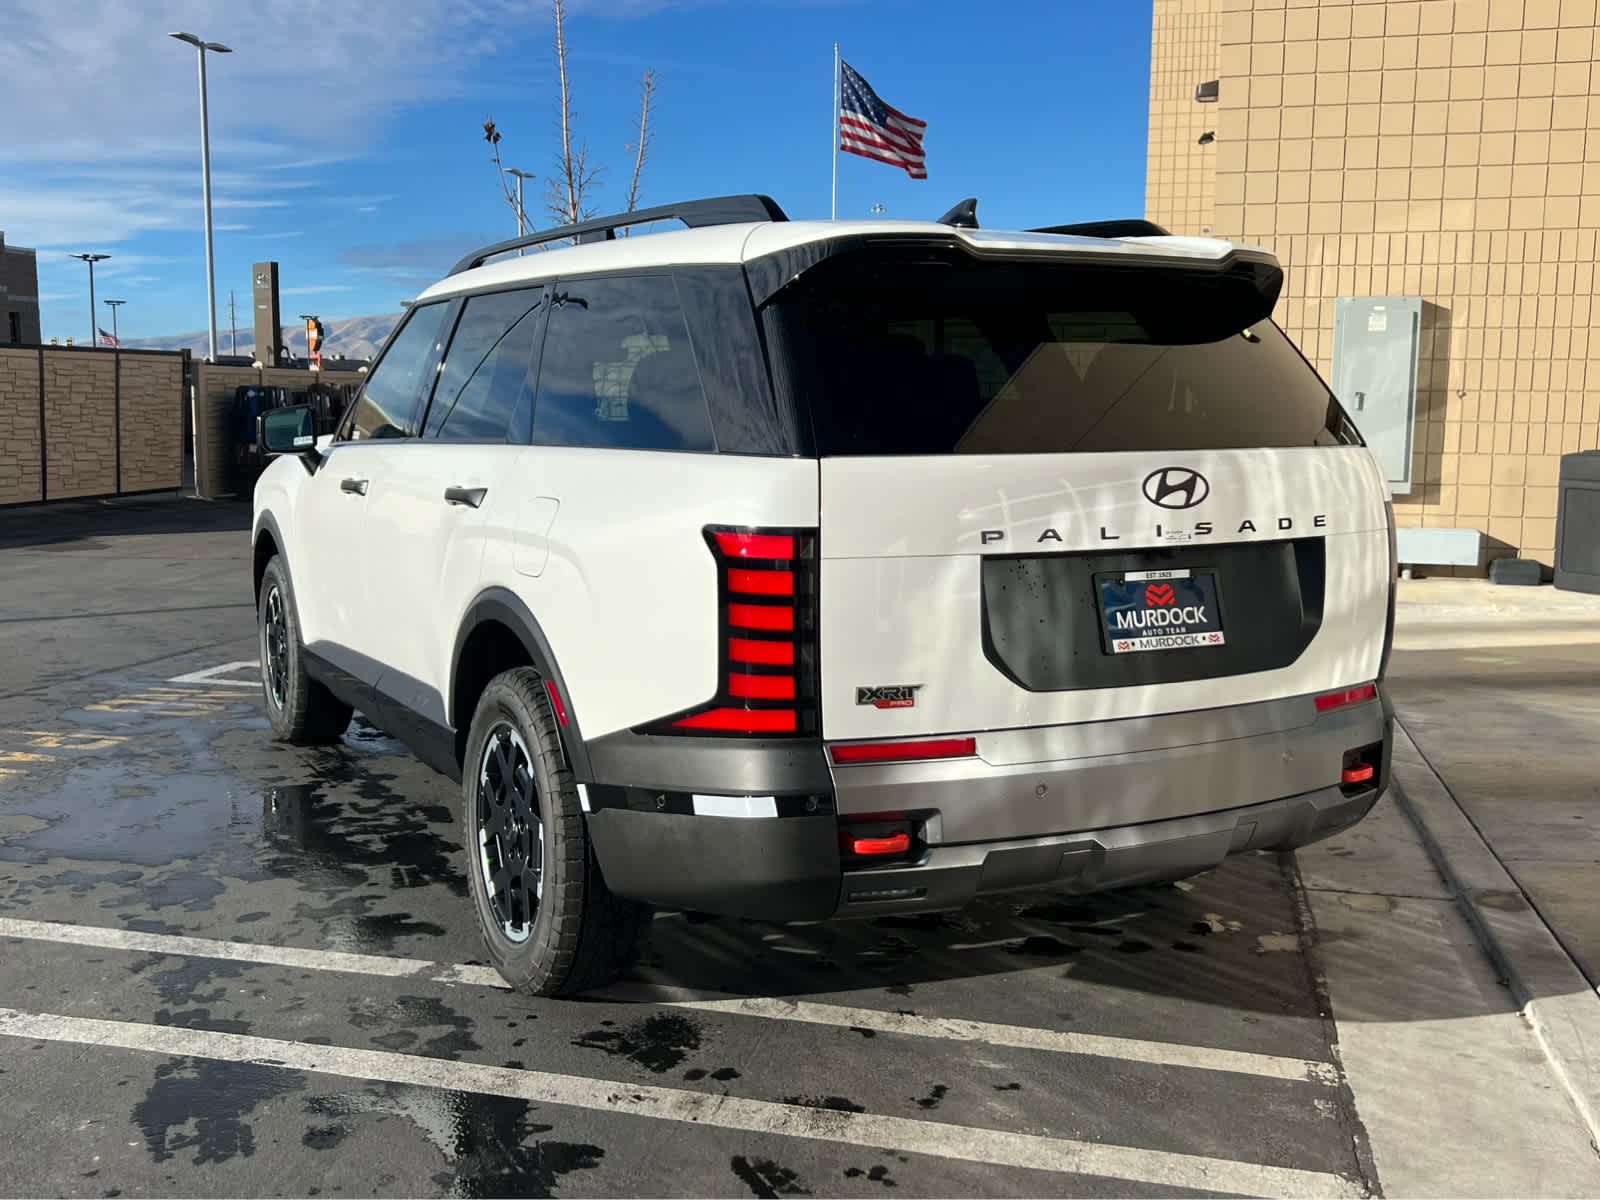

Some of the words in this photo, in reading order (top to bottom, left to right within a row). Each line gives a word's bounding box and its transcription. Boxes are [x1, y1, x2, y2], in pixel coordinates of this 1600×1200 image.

[980, 515, 1327, 545] PALISADE
[1116, 606, 1208, 630] MURDOCK
[1142, 628, 1164, 637] AUTO
[1166, 626, 1187, 635] TEAM
[1139, 635, 1200, 649] MURDOCK
